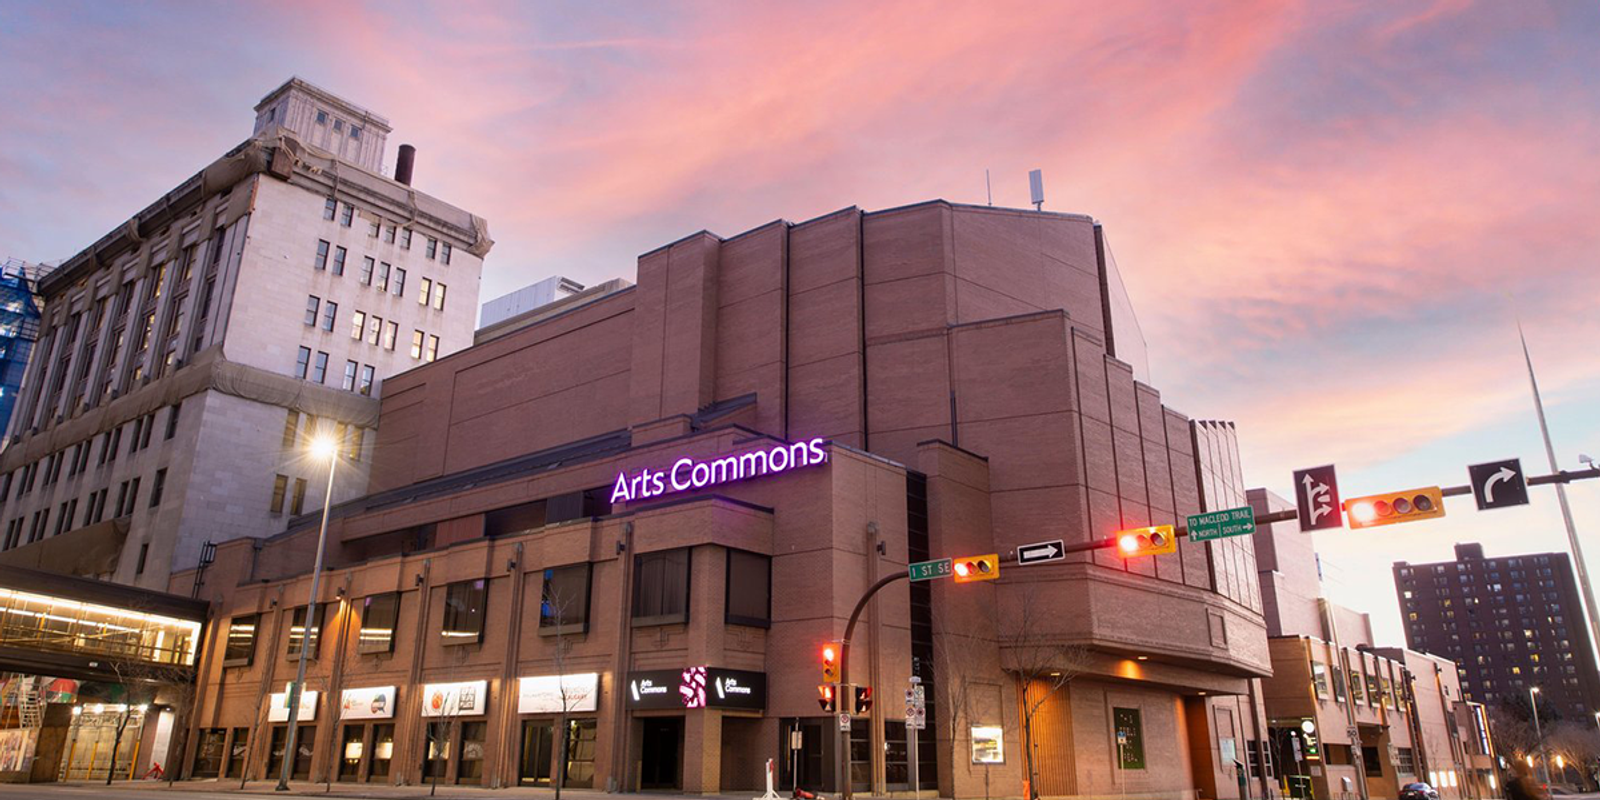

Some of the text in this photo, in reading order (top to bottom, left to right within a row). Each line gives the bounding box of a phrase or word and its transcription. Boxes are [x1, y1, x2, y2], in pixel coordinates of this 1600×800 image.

[610, 437, 825, 503] Arts Commons
[1189, 510, 1250, 527] TO MACLEOD TRAIL
[1199, 529, 1218, 538] NORTH
[1223, 525, 1242, 535] SOUTH
[921, 565, 932, 576] ST
[938, 562, 950, 573] SE
[640, 679, 653, 687] Arts
[725, 678, 737, 686] Arts
[640, 686, 667, 694] Commons
[725, 685, 751, 694] Commons
